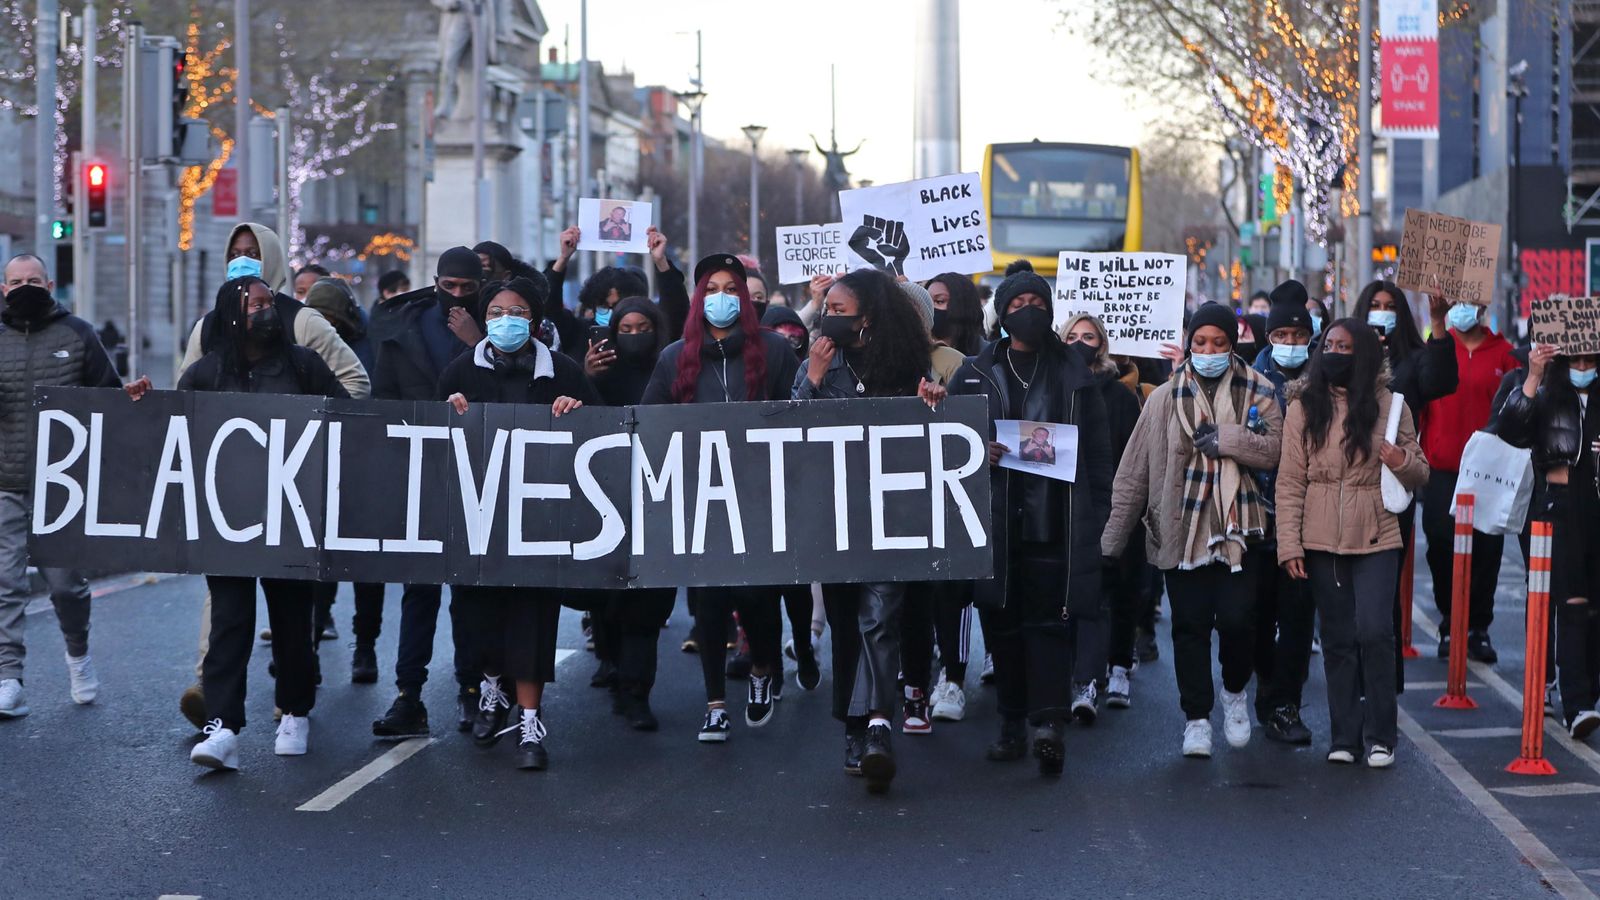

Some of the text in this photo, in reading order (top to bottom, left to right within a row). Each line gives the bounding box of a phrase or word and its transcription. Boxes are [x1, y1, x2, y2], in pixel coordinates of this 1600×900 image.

[920, 183, 972, 204] BLACK
[1406, 210, 1425, 230] WE
[1429, 218, 1457, 233] NEED
[783, 230, 841, 245] JUSTICE
[1403, 231, 1486, 258] AS LOUD AS WE
[784, 246, 836, 261] GEORGE
[920, 235, 985, 260] MATTERS
[1401, 245, 1419, 259] CAN
[1425, 250, 1441, 262] SO
[1065, 258, 1090, 272] WE
[1144, 258, 1174, 270] NOT
[1079, 275, 1098, 290] BE
[1057, 289, 1077, 301] WE
[1118, 292, 1143, 301] NOT
[1147, 292, 1161, 301] BE
[1103, 302, 1153, 314] BROKEN,
[1531, 299, 1562, 311] NOT
[1465, 468, 1516, 488] TOPMAN
